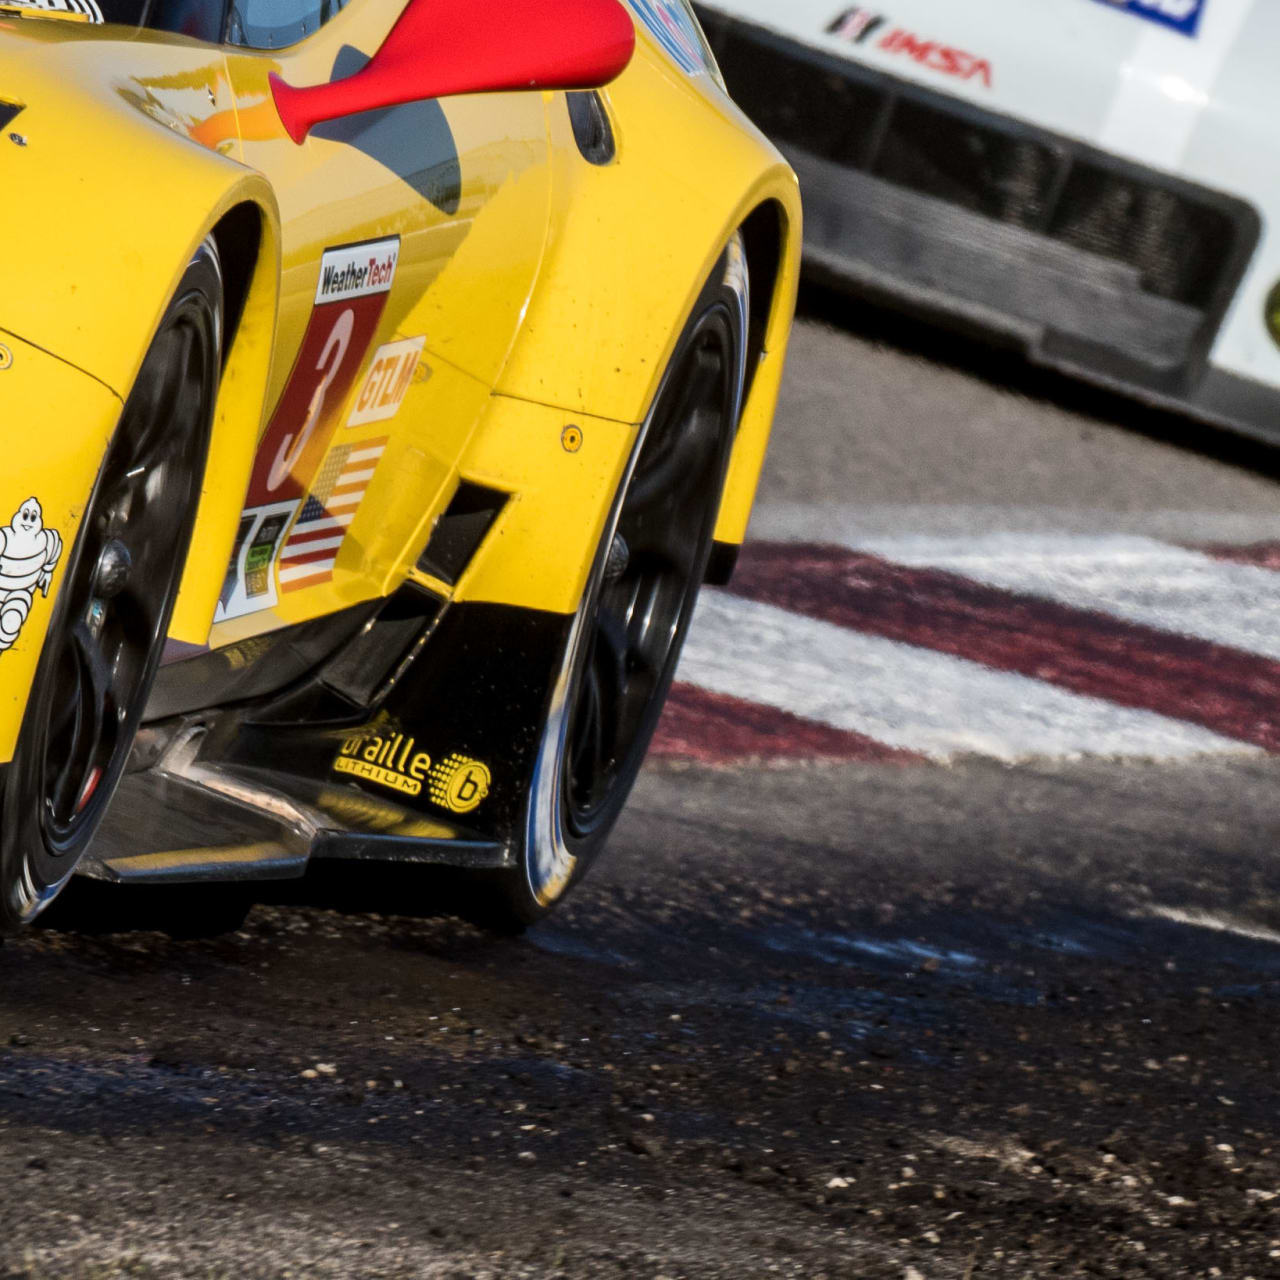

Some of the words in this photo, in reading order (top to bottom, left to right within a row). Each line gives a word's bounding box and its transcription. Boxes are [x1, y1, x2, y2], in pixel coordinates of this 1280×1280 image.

[879, 26, 993, 88] IMSA
[321, 254, 394, 296] WeatherTech
[266, 307, 355, 493] 3
[356, 349, 420, 413] GTLM
[335, 757, 420, 794] LITHIUM
